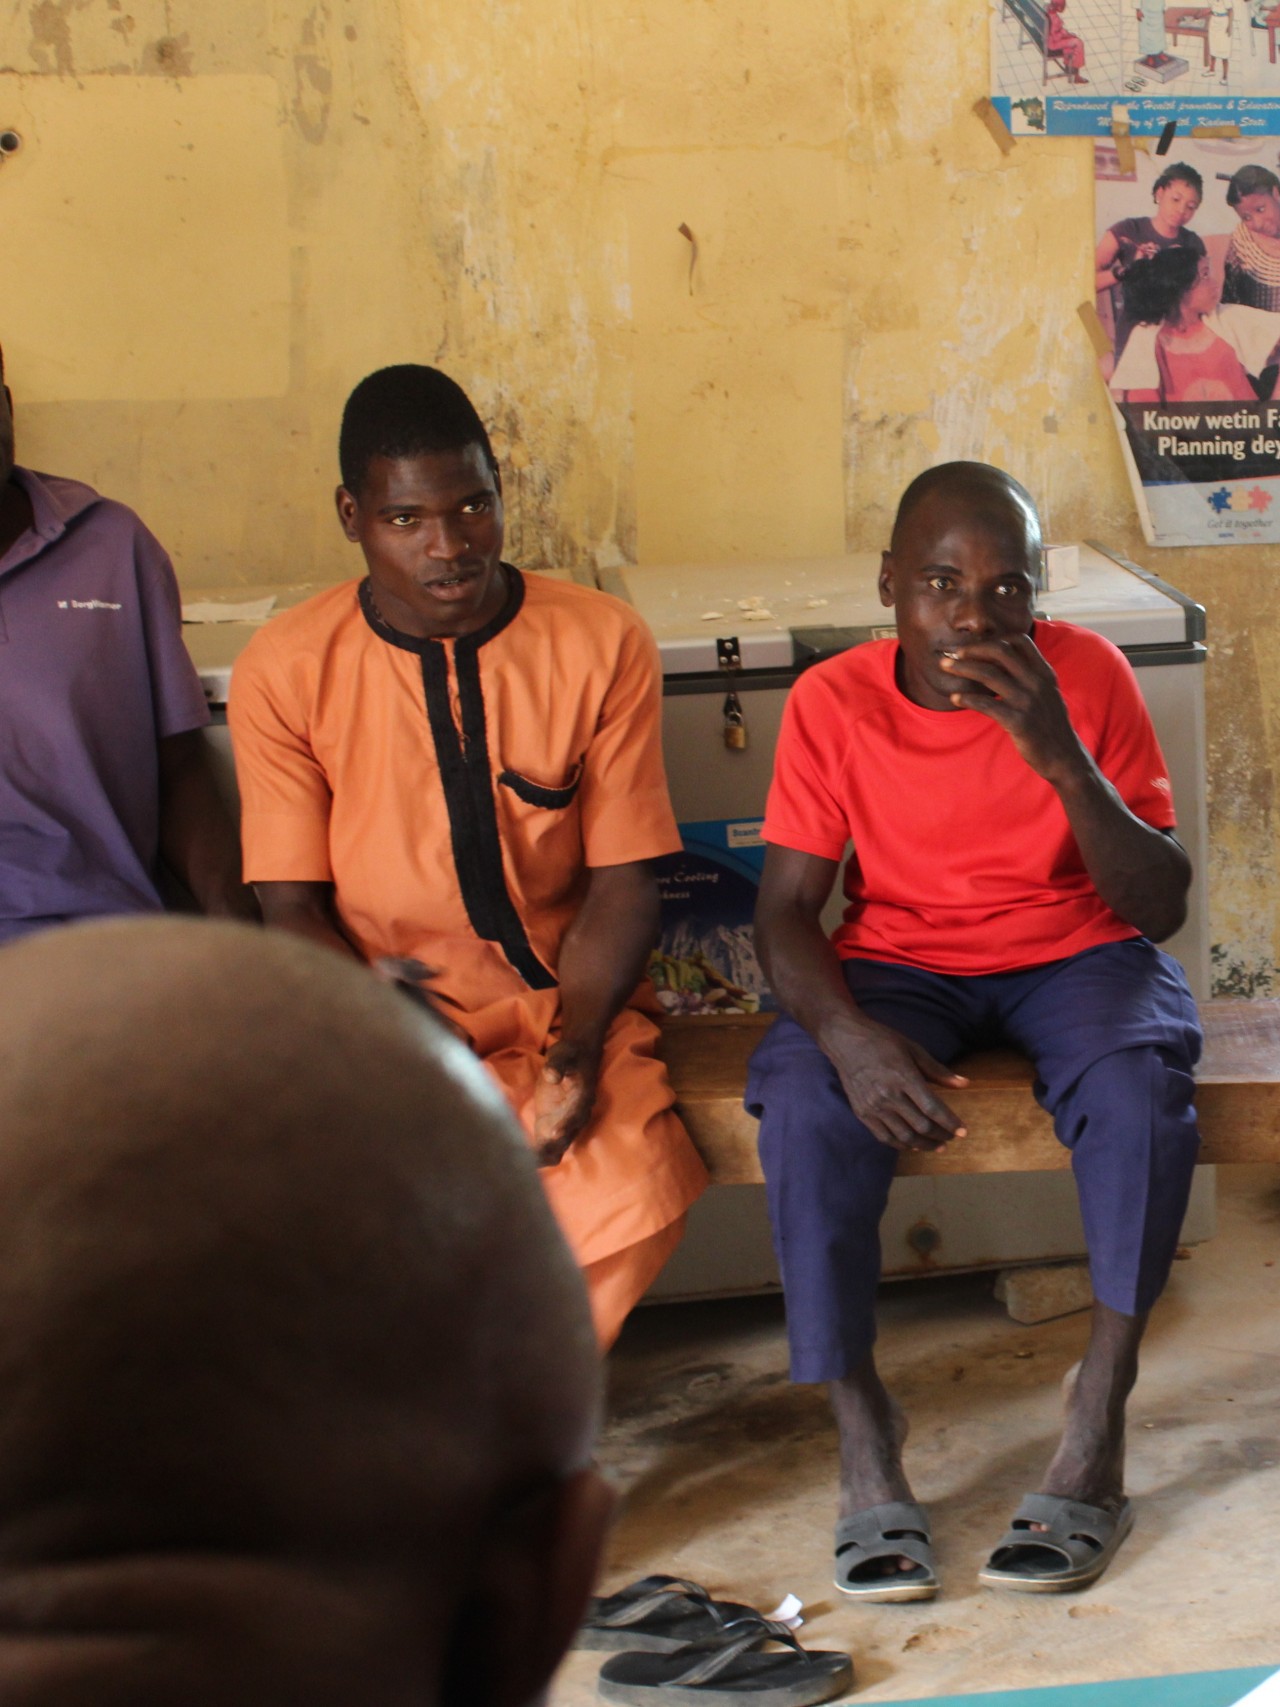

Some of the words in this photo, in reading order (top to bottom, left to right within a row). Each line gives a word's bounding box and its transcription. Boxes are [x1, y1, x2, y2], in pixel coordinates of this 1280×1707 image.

[1143, 99, 1176, 110] Health
[1143, 411, 1200, 431] Know
[1205, 409, 1261, 430] wetin
[1158, 435, 1246, 460] Planning
[1207, 519, 1223, 528] Get
[1234, 518, 1274, 530] together
[673, 871, 719, 884] Cooling
